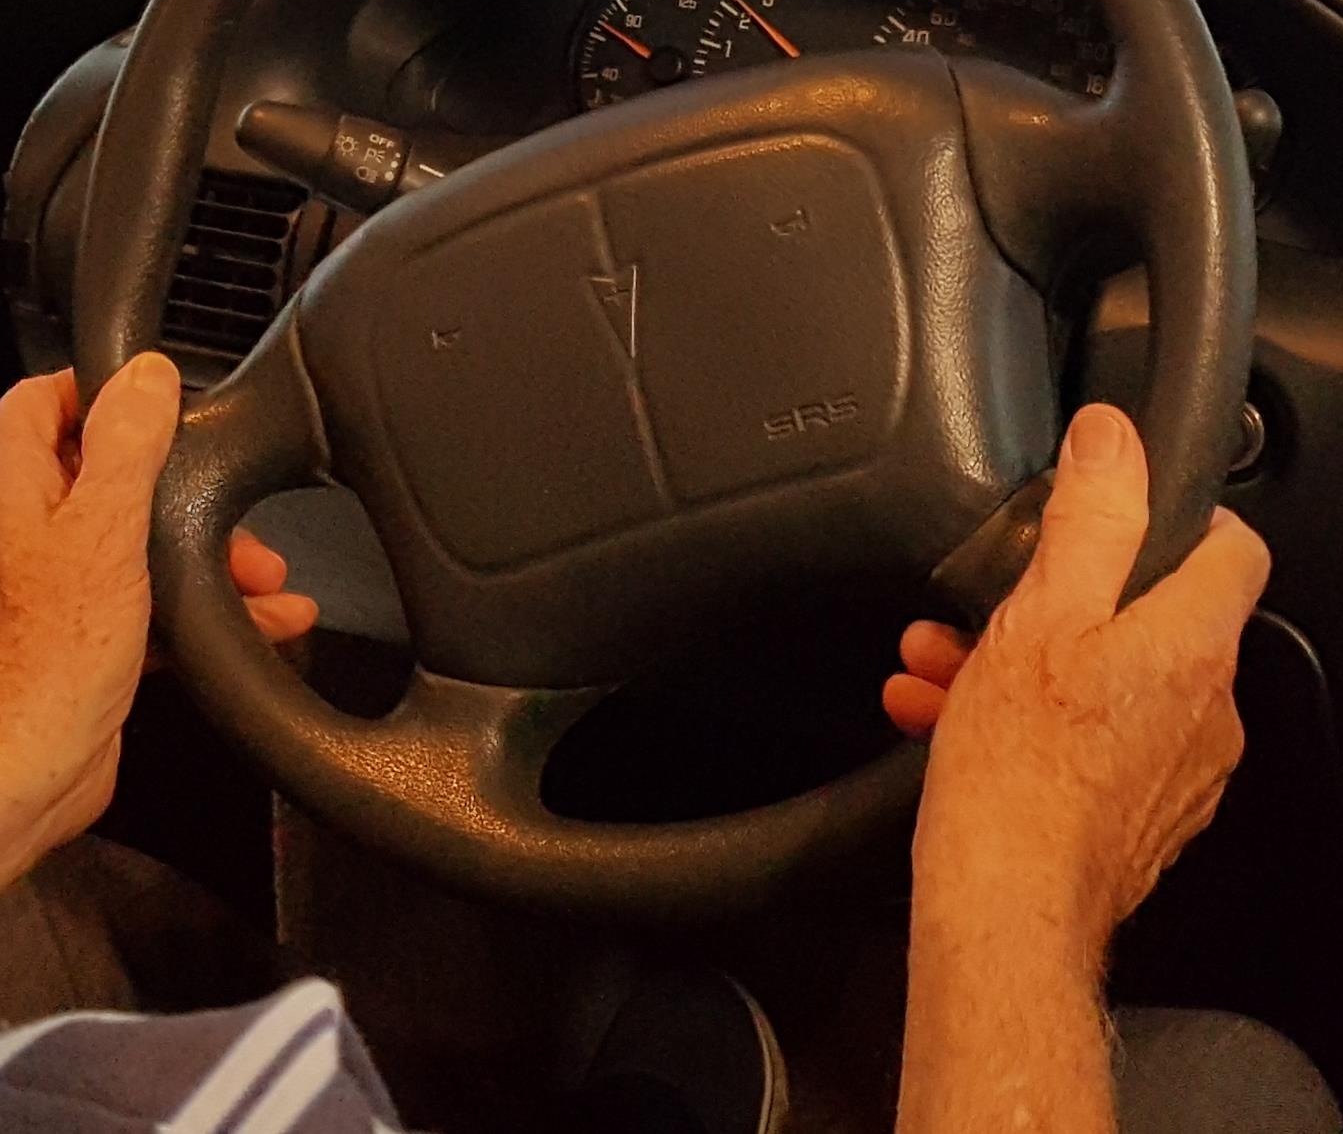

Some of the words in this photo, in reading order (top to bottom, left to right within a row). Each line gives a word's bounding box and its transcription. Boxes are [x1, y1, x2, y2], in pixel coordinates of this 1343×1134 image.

[624, 14, 643, 29] 90
[738, 14, 752, 31] 2
[902, 30, 931, 46] 40
[723, 40, 733, 58] 1
[600, 67, 620, 82] 40
[368, 133, 396, 149] OFF
[762, 393, 858, 442] SRS
